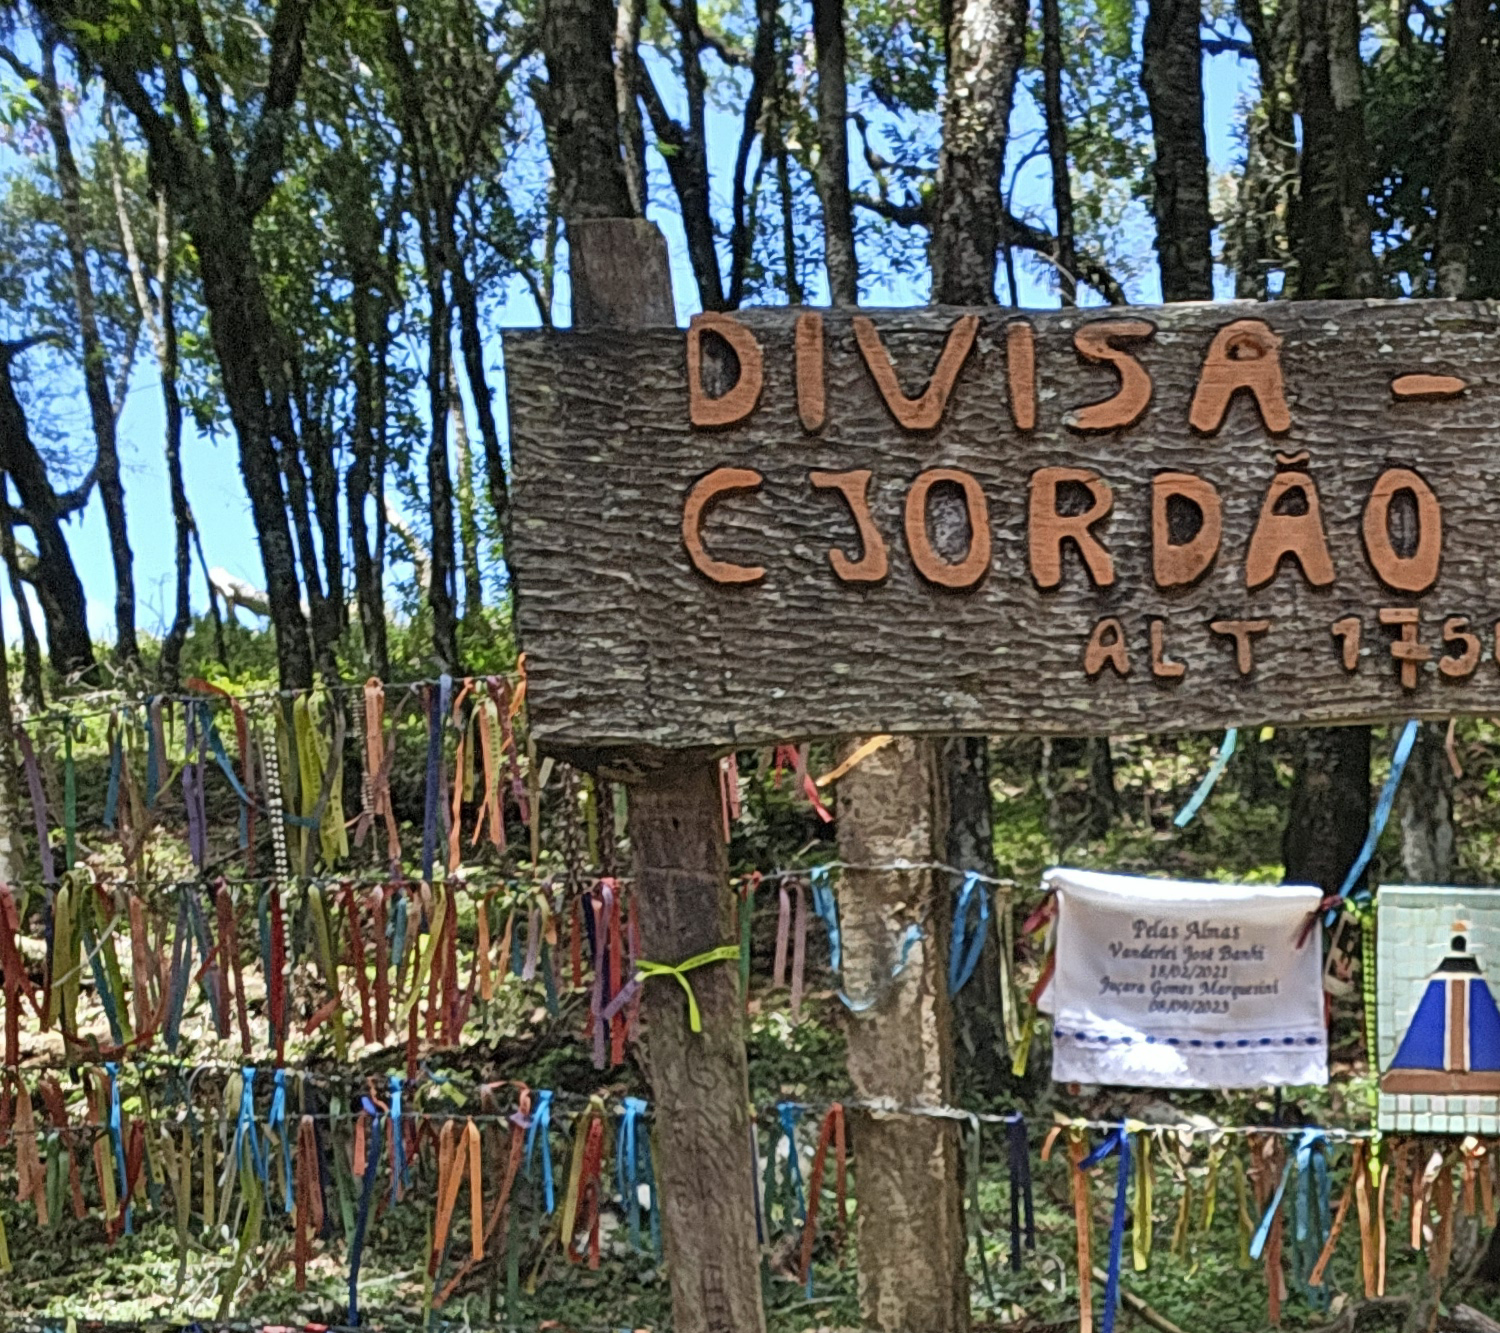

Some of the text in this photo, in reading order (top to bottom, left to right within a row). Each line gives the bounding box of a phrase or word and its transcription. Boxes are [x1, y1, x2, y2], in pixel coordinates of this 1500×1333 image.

[686, 311, 1292, 433] DIVISA
[682, 466, 765, 584] C
[808, 450, 1442, 593] JORDÃO
[1084, 617, 1271, 678] ALT
[1131, 918, 1241, 941] Pelas Almas
[1150, 979, 1194, 999] Gomes
